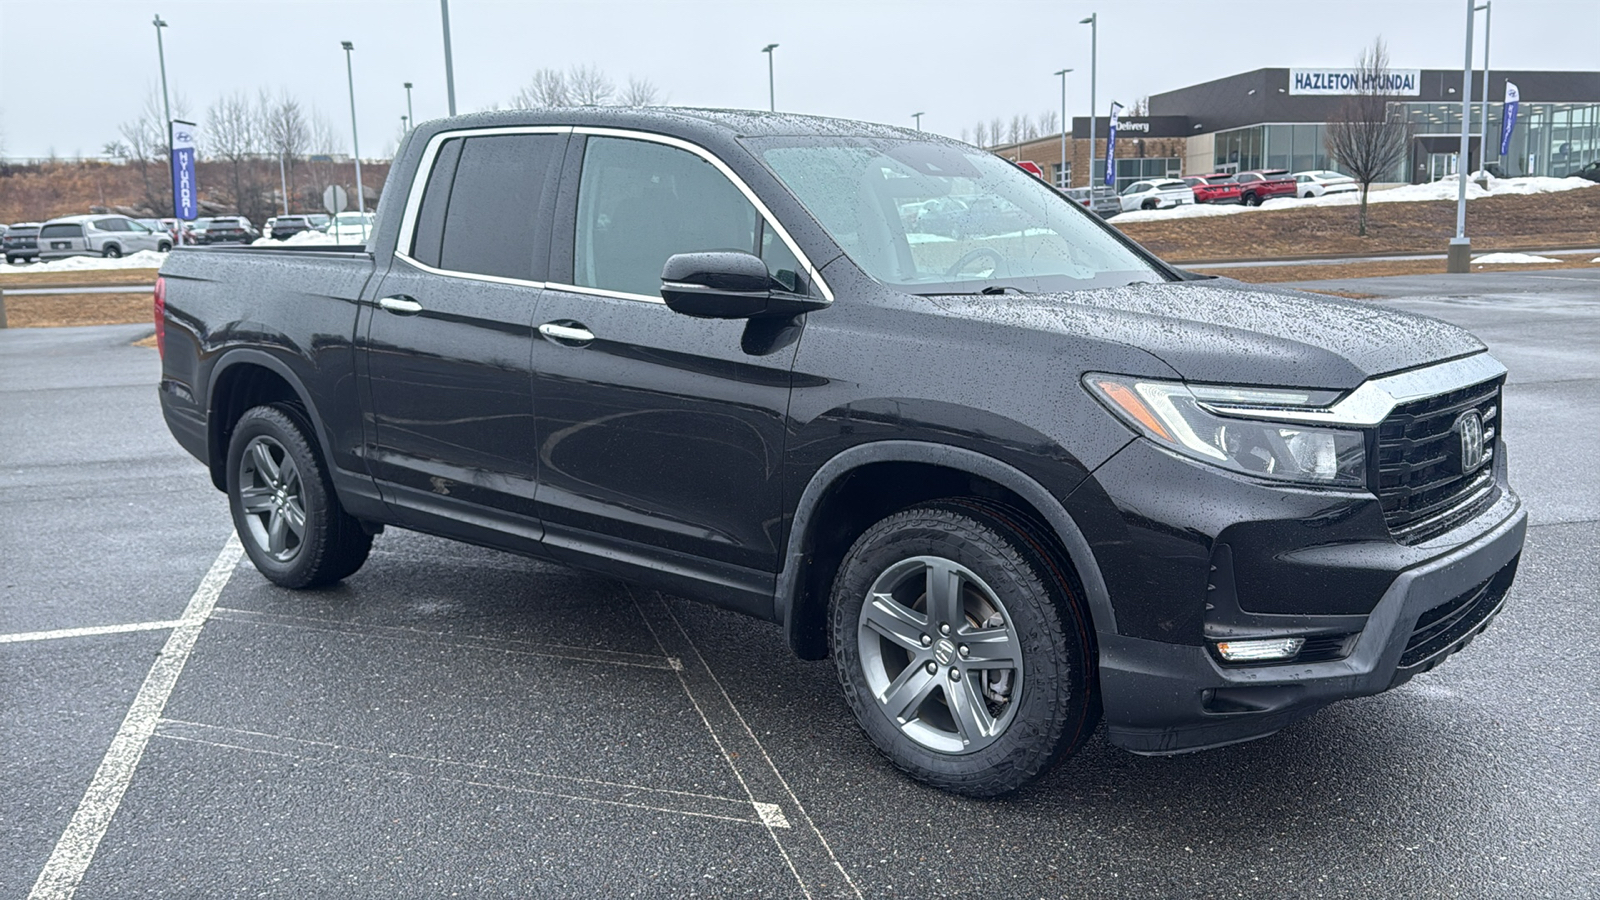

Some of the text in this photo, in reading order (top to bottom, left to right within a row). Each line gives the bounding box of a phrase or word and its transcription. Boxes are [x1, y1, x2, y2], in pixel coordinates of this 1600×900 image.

[1295, 73, 1415, 90] HAZLETON HYUNDAI
[1116, 121, 1150, 133] Delivery
[179, 151, 191, 217] HYUNDAI
